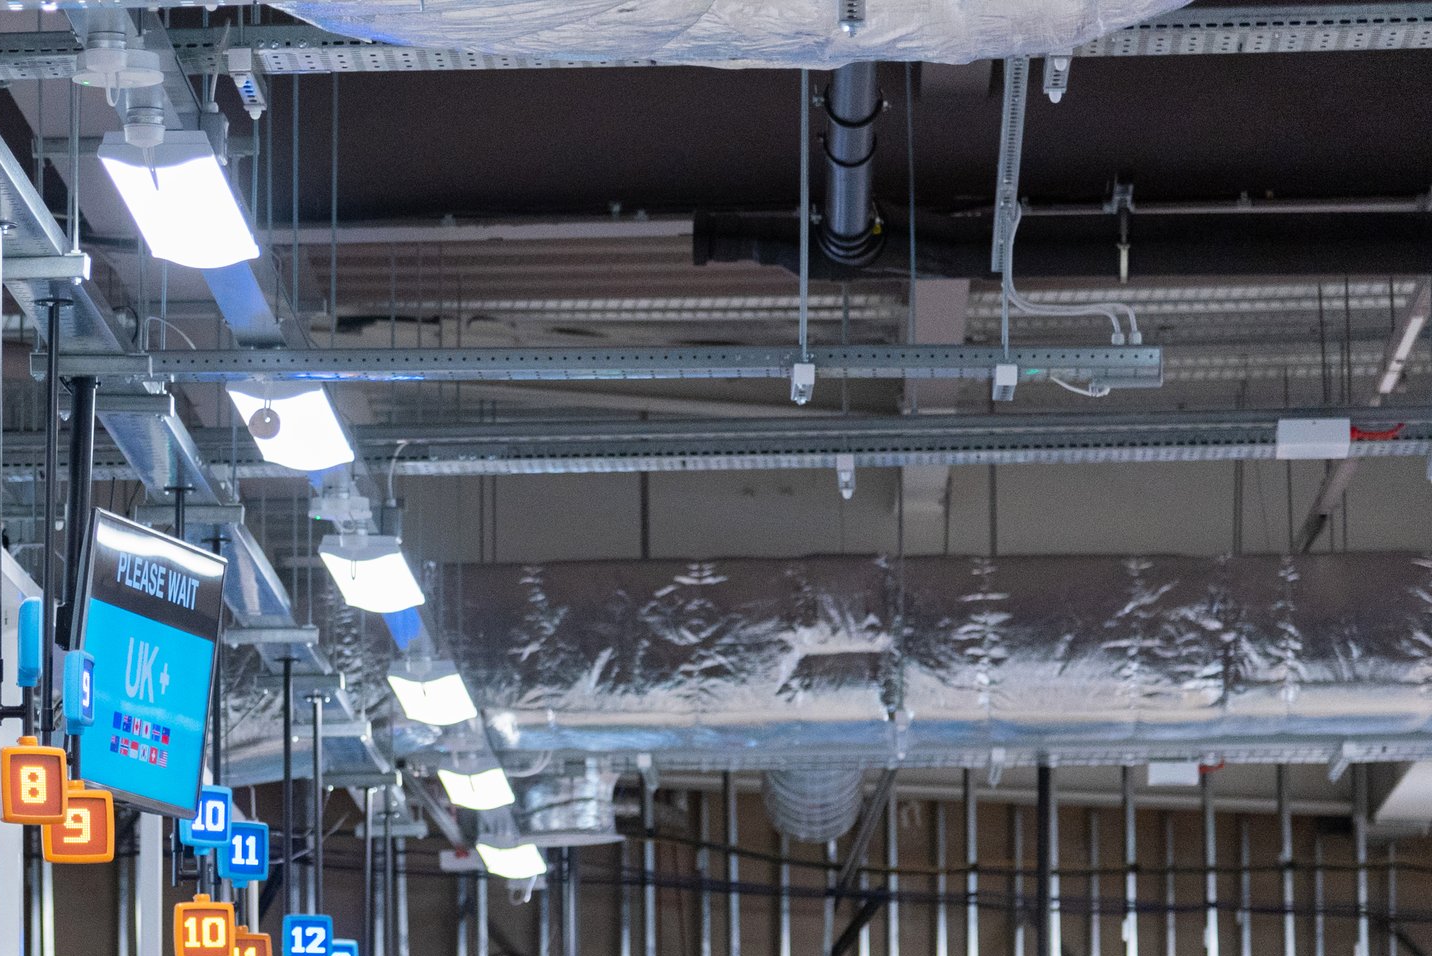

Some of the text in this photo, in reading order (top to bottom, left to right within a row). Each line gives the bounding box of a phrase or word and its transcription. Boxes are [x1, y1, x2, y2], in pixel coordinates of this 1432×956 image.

[117, 551, 200, 610] PLEASE WAIT
[82, 671, 90, 707] 9
[20, 765, 47, 803] 8
[63, 808, 91, 843] 9
[191, 799, 226, 832] 10
[232, 834, 259, 866] 11
[184, 916, 226, 948] 10
[290, 926, 327, 954] 12
